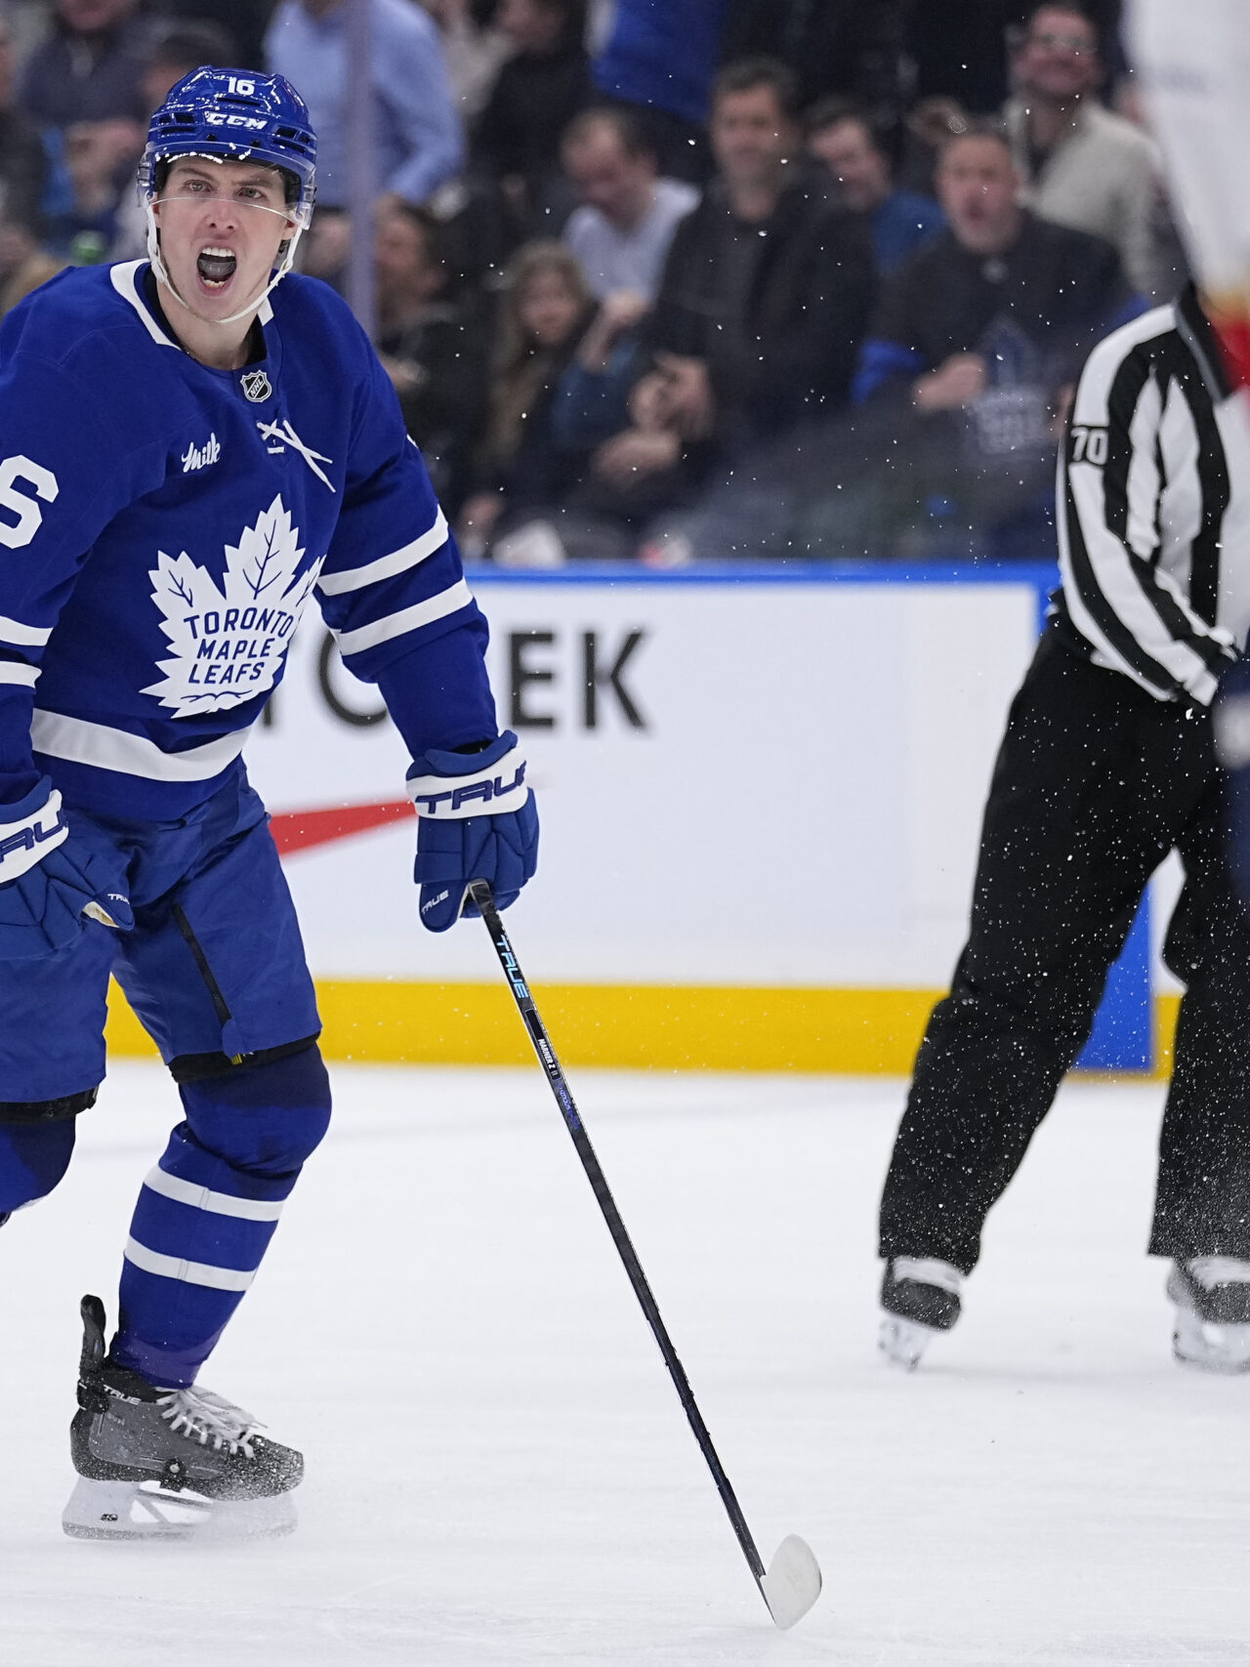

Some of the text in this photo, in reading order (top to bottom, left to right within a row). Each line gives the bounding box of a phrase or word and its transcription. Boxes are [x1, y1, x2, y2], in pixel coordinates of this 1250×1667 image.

[228, 76, 256, 96] 16
[206, 111, 269, 130] CCM
[181, 432, 221, 473] Milk
[1070, 426, 1109, 465] 70
[183, 607, 295, 640] TORONTO
[196, 638, 276, 661] MAPLE
[188, 661, 265, 684] LEAFS
[415, 758, 528, 815] TRU
[421, 889, 450, 915] TRUE
[496, 933, 530, 999] TRUE
[103, 1384, 142, 1406] TRUE
